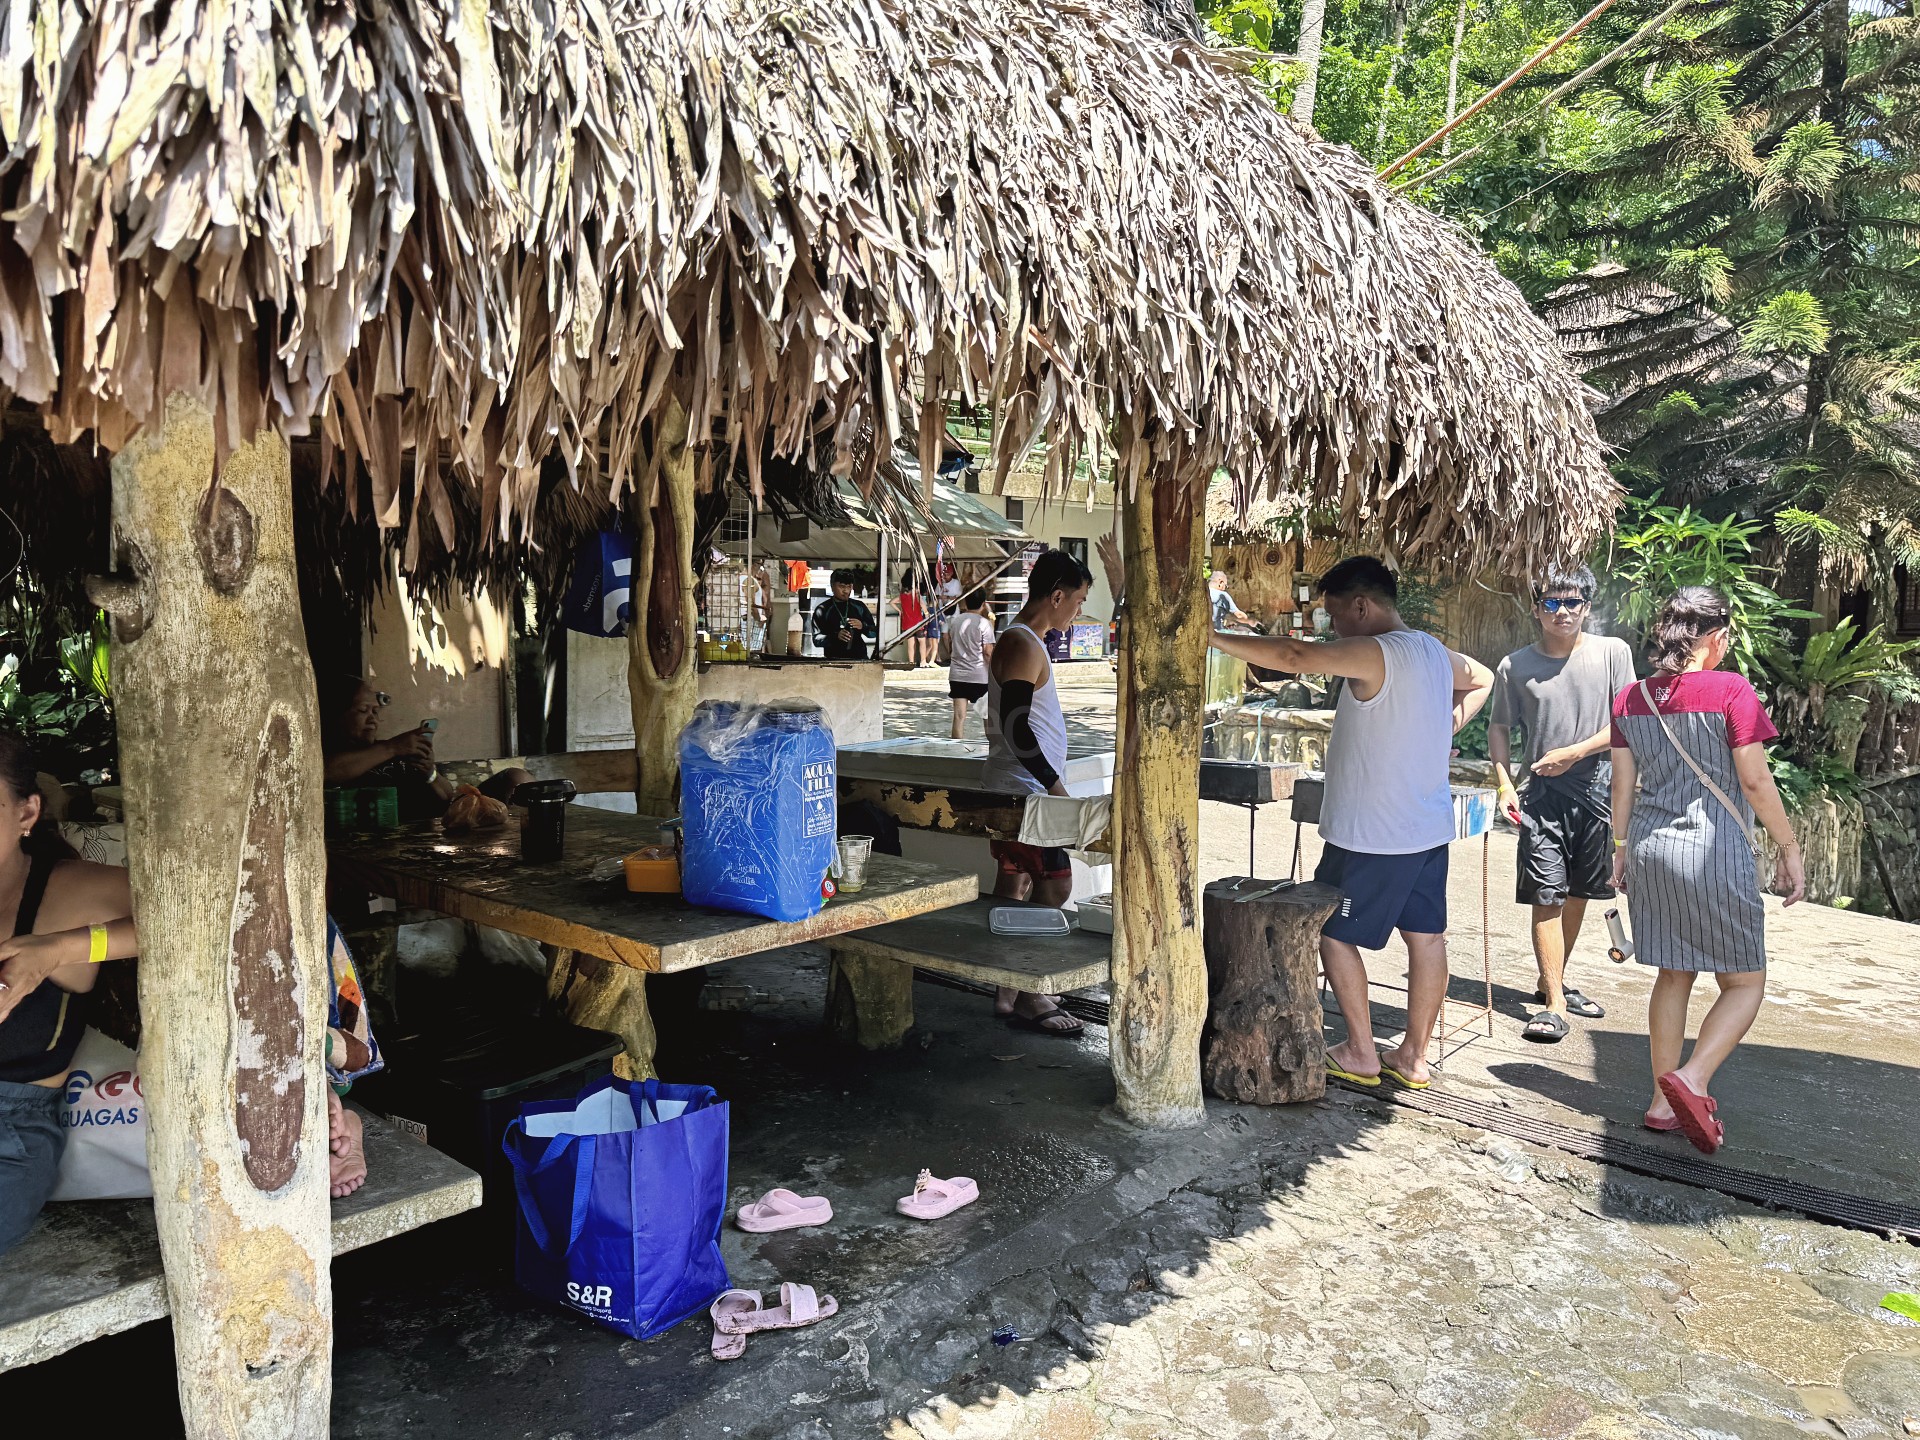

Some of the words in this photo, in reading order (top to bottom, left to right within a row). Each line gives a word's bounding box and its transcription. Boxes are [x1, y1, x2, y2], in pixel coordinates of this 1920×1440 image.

[804, 763, 833, 780] AQUA
[808, 776, 831, 792] FILL
[566, 1281, 613, 1307] S&R
